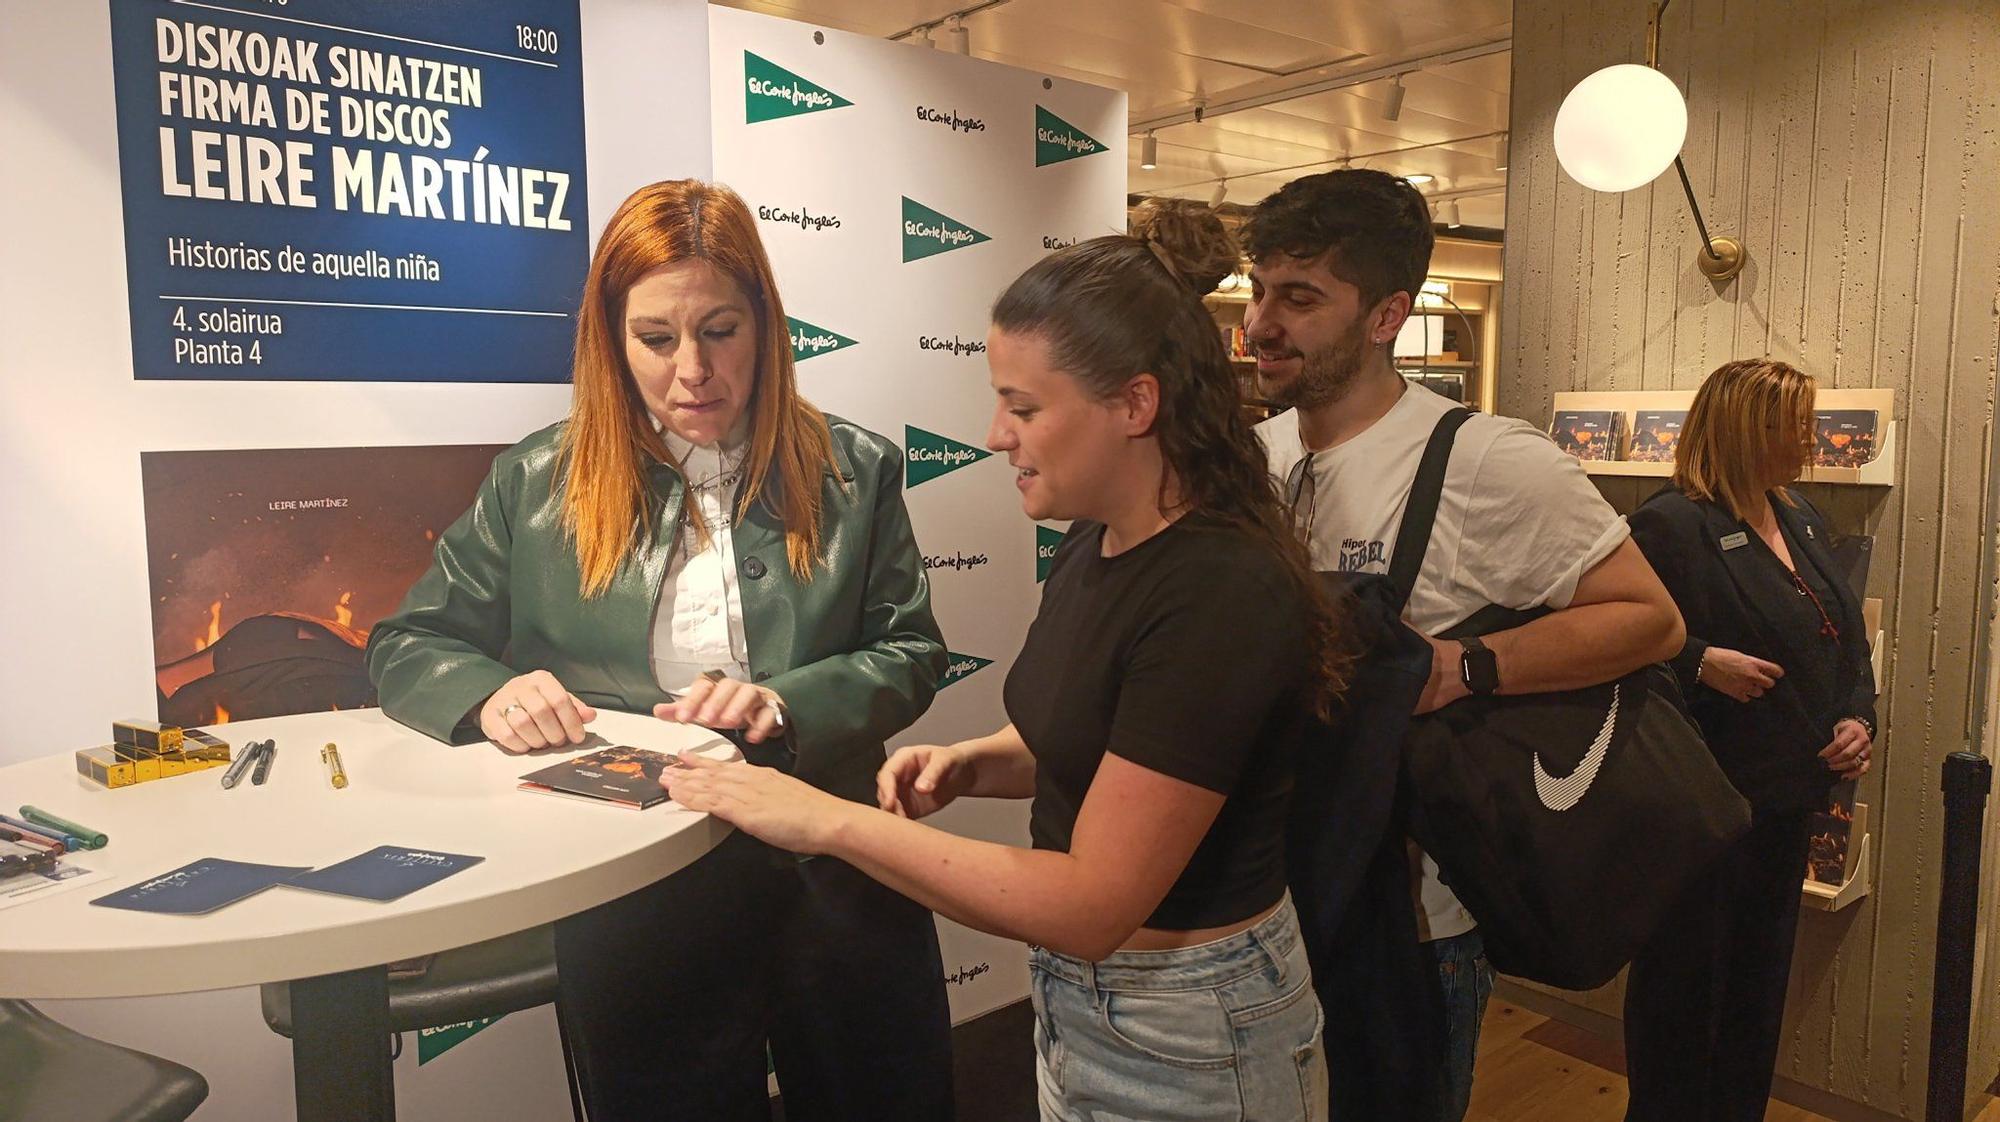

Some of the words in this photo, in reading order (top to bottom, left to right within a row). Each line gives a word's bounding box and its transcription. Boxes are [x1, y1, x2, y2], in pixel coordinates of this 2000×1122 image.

[515, 24, 558, 55] 18:00
[156, 18, 321, 85] DISKOAK
[329, 46, 482, 108] SINATZEN
[748, 77, 763, 94] El
[762, 81, 791, 99] Corte
[792, 82, 832, 108] Inglés
[159, 71, 277, 129] FIRMA
[286, 88, 332, 135] DE
[341, 96, 452, 149] DISCOS
[917, 106, 927, 120] El
[928, 108, 951, 124] Corte
[952, 109, 985, 132] Inglés
[1038, 127, 1047, 141] El
[1047, 130, 1066, 146] Corte
[1067, 130, 1095, 153] Inglés
[160, 126, 318, 208] LEIRE
[331, 145, 572, 231] MARTÍNEZ
[759, 205, 771, 221] El
[772, 208, 800, 224] Corte
[801, 207, 841, 231] Inglés
[905, 220, 916, 236] El
[916, 222, 940, 239] Corte
[940, 221, 974, 245] Inglés
[168, 238, 272, 273] Historias
[278, 244, 306, 274] de
[312, 249, 391, 281] aquella
[396, 254, 440, 282] niña
[172, 306, 193, 333] 4.
[198, 307, 282, 336] solairua
[175, 338, 243, 365] Planta
[248, 340, 263, 365] 4
[798, 327, 838, 352] Inglés
[920, 336, 930, 350] El
[930, 337, 953, 351] Corte
[954, 335, 986, 357] Inglés
[909, 447, 920, 461] El
[920, 448, 943, 461] Corte
[943, 444, 976, 466] Inglés
[269, 501, 297, 511] LEIRE
[299, 498, 348, 509] MARTÍNEZ
[1338, 541, 1386, 571] REBEL
[1341, 538, 1367, 550] Hiper
[933, 556, 956, 569] Corte
[956, 551, 988, 571] Inglés
[959, 962, 990, 985] Inglés
